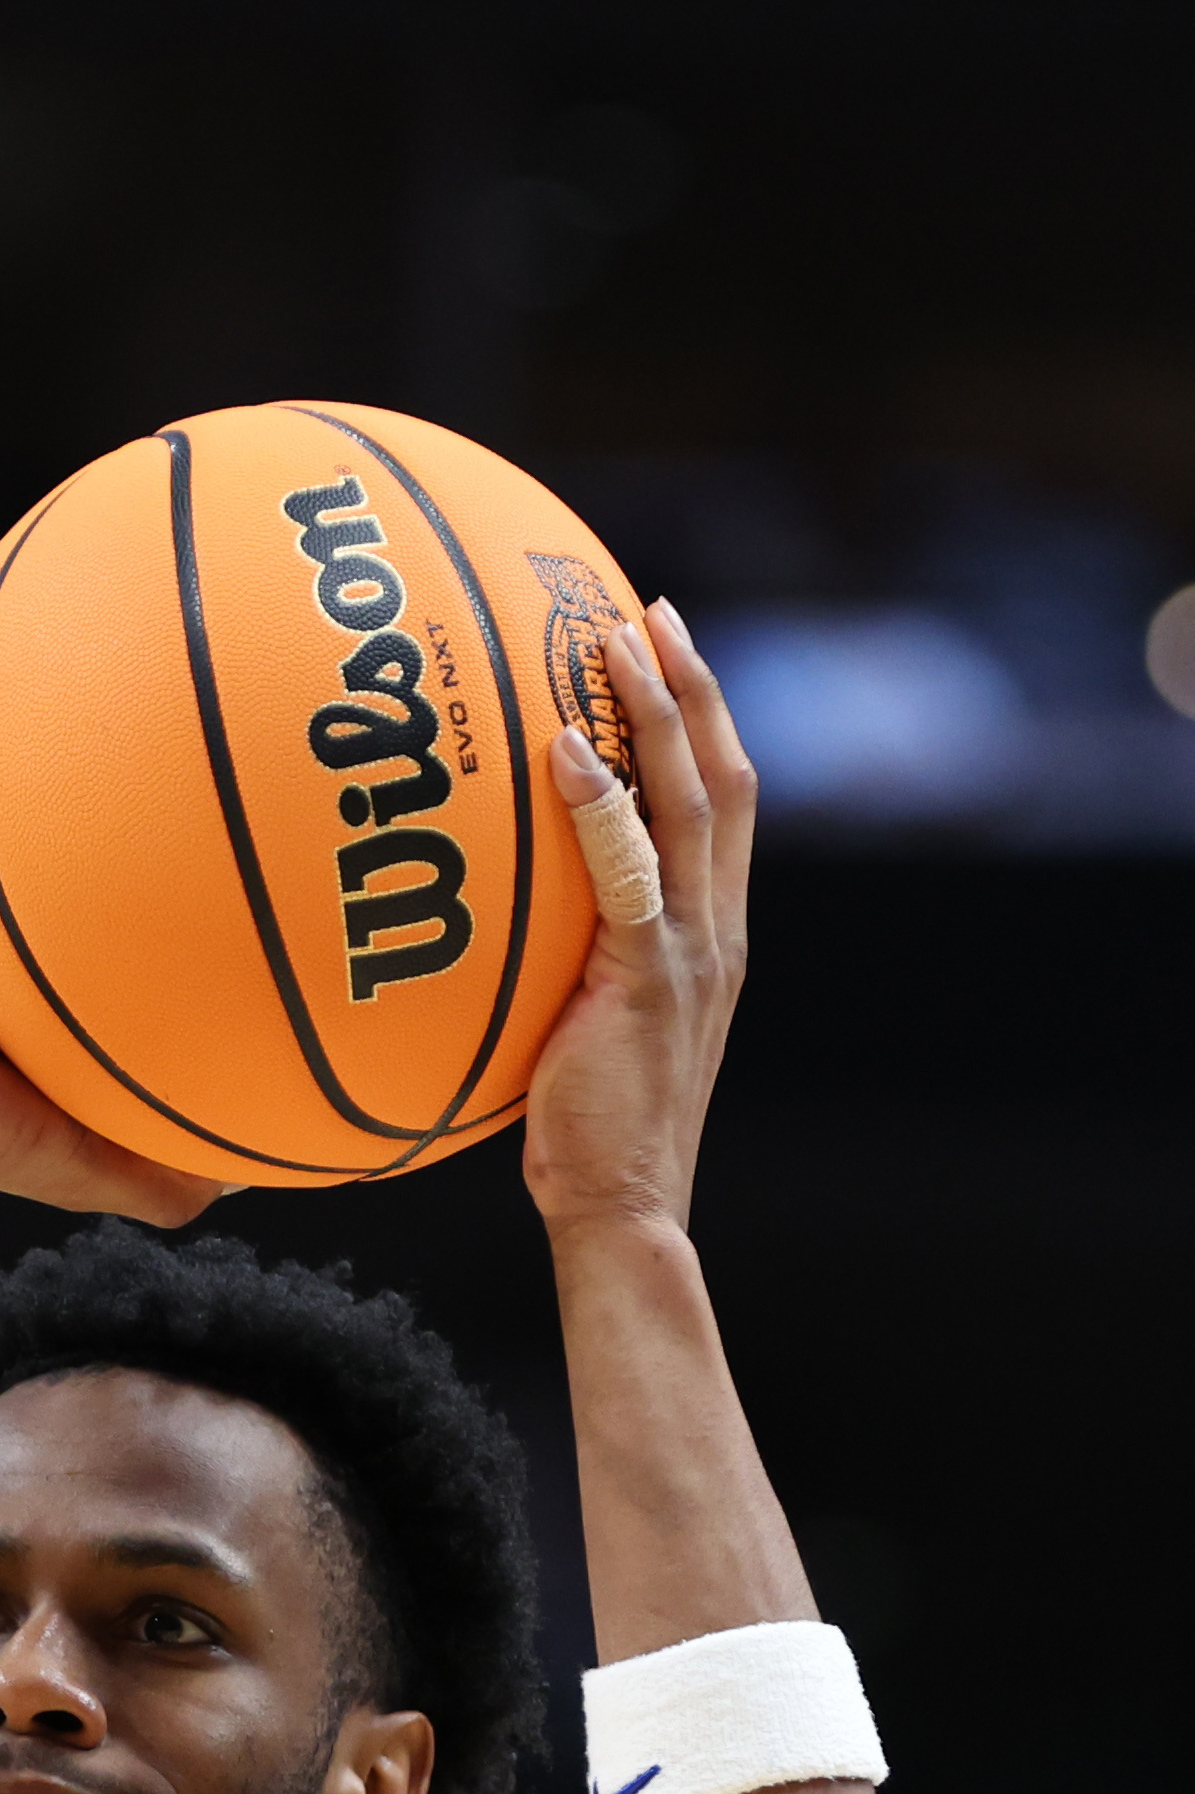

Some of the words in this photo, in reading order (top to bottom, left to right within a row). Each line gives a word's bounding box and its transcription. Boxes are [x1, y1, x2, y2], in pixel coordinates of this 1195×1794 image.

[425, 619, 460, 688] NXT
[567, 618, 621, 760] MARCH
[557, 675, 581, 723] SWEET
[281, 475, 475, 1003] Wilson
[448, 700, 479, 775] EVO
